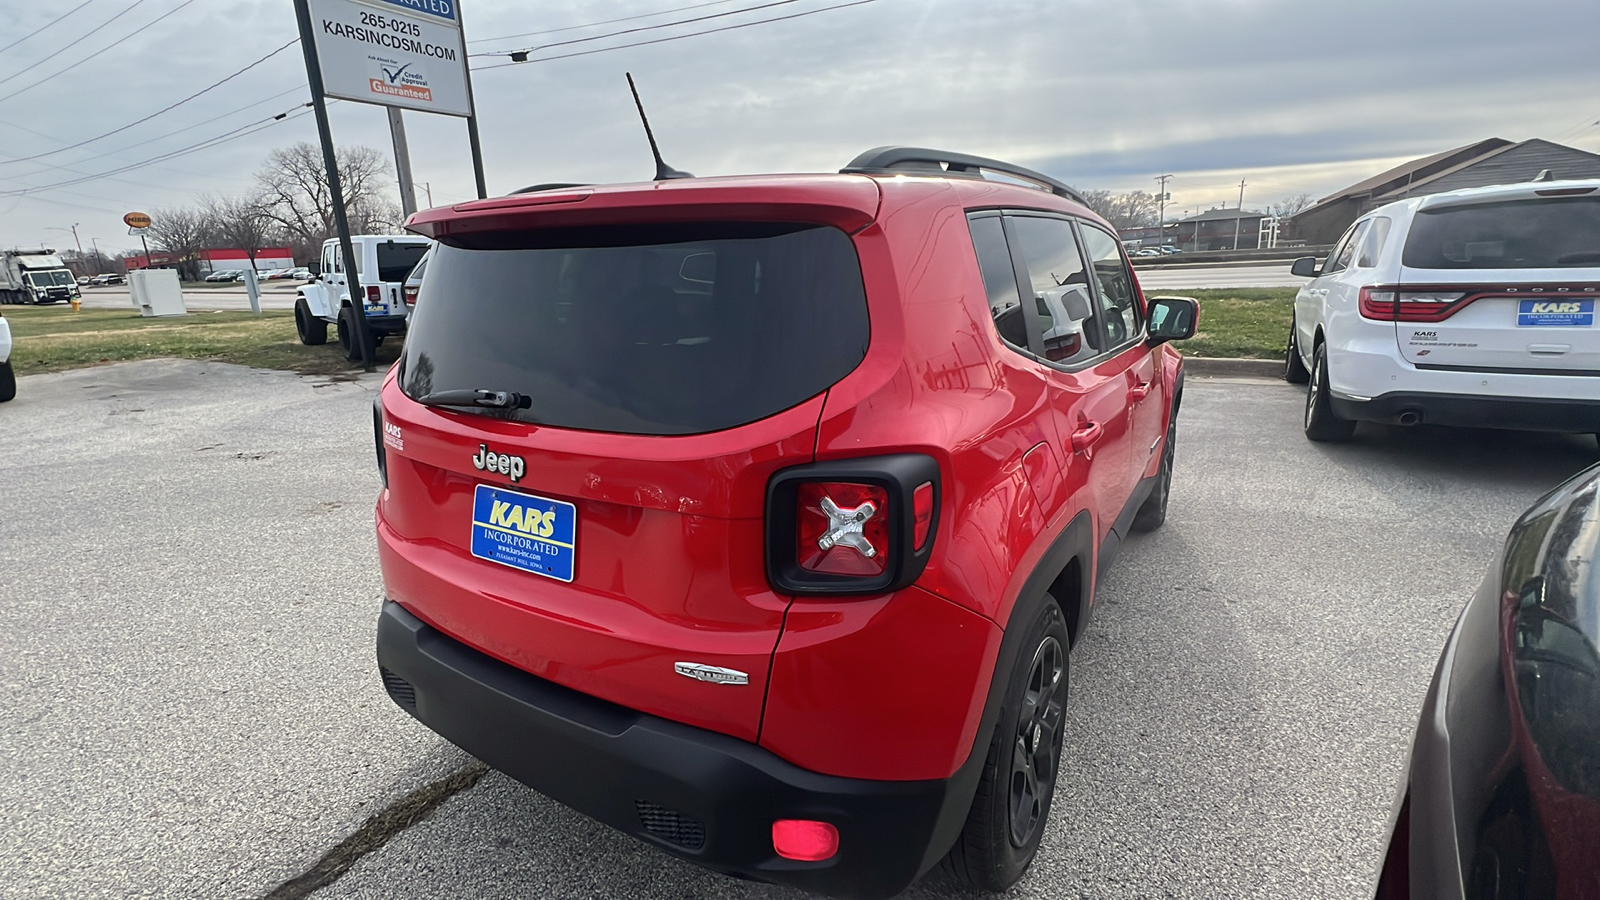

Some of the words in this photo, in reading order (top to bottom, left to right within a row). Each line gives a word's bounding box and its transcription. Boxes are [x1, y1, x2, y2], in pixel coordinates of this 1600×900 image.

[400, 0, 450, 14] ATED
[360, 11, 421, 37] 265-0215
[322, 19, 456, 61] KARSINCDSM.COM
[401, 77, 428, 86] Approval
[404, 71, 423, 80] Credit
[372, 80, 430, 100] Guaranteed
[1532, 302, 1581, 313] KARS
[385, 421, 401, 438] KARS
[472, 443, 526, 482] Jeep
[489, 499, 556, 537] KARS
[484, 528, 559, 556] INCORPORATED
[497, 544, 542, 561] www.kars-inc.com
